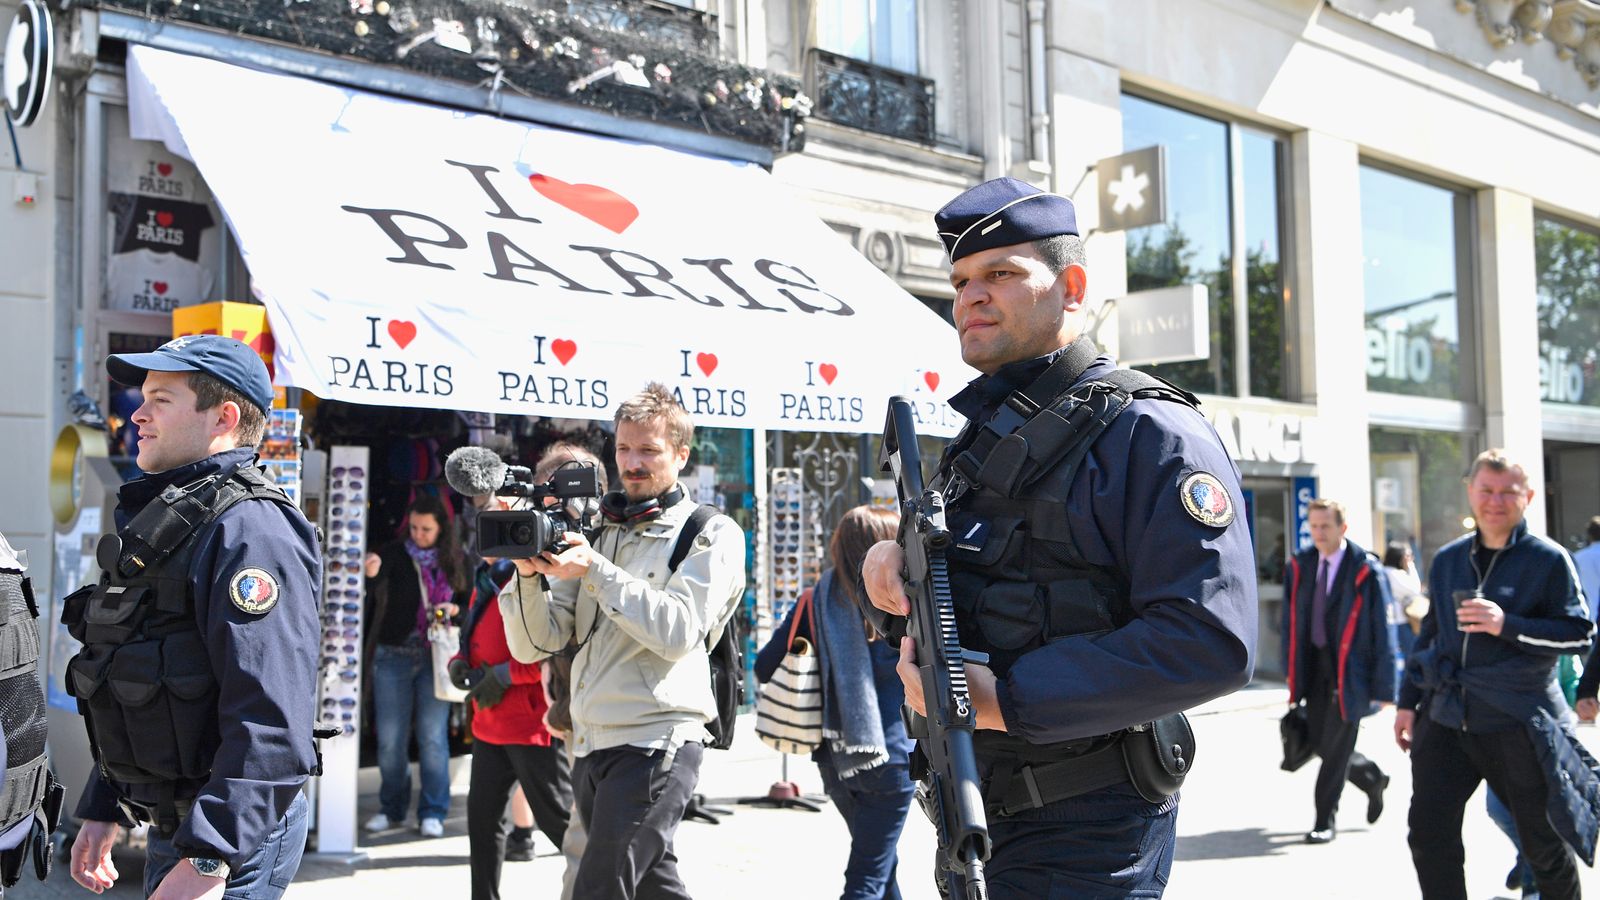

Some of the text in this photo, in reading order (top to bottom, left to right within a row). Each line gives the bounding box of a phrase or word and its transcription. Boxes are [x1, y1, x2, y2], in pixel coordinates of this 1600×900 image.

[147, 161, 157, 176] I
[138, 176, 184, 197] PARIS
[444, 158, 542, 224] I
[146, 209, 156, 225] I
[136, 224, 185, 246] PARIS
[340, 204, 855, 317] PARIS
[143, 279, 153, 294] I
[132, 294, 180, 313] PARIS
[366, 316, 382, 349] I
[533, 335, 547, 365] I
[680, 349, 692, 378] I
[327, 356, 454, 397] PARIS
[805, 360, 815, 387] I
[497, 371, 609, 410] PARIS
[672, 386, 747, 418] ARIS
[780, 393, 864, 424] PARIS
